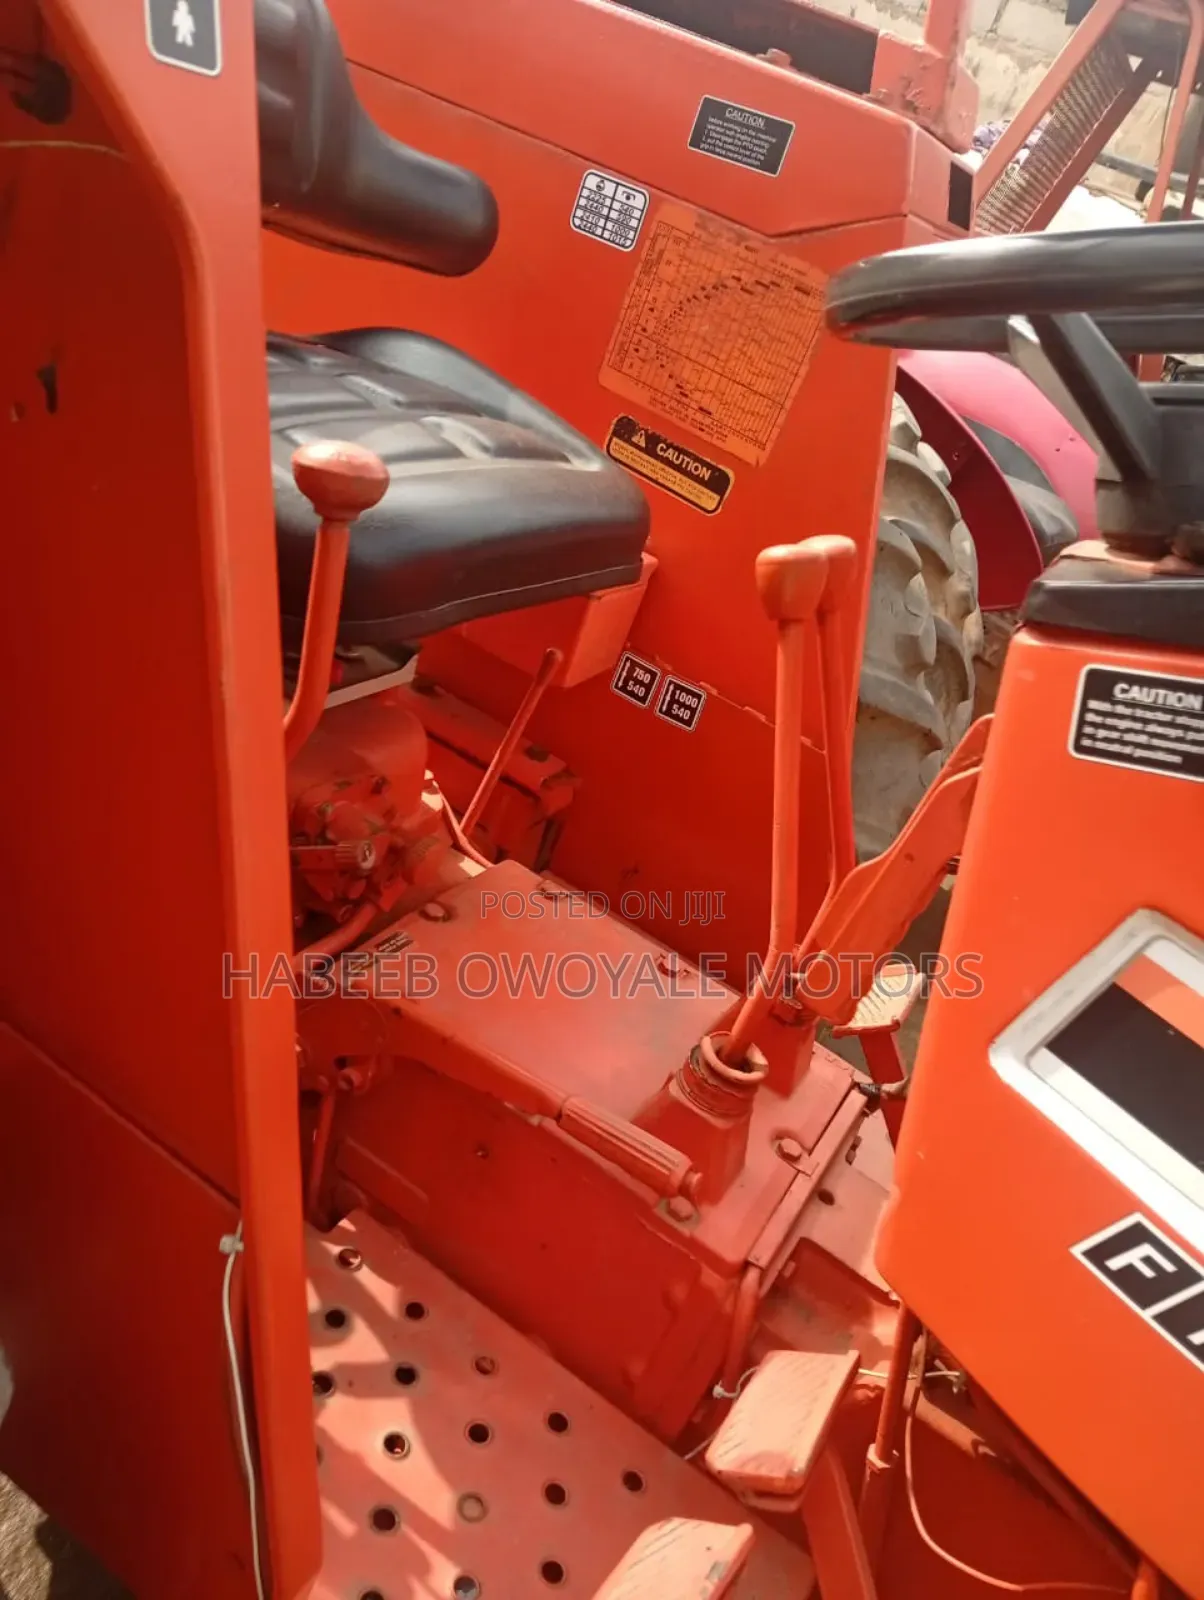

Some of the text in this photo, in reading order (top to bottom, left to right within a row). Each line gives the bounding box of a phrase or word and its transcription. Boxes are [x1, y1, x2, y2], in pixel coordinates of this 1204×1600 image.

[656, 443, 712, 481] CAUTION
[633, 667, 651, 684] 750
[627, 680, 646, 697] 540
[1112, 682, 1204, 711] CAUTION
[675, 690, 698, 708] 1000
[671, 704, 691, 720] 540
